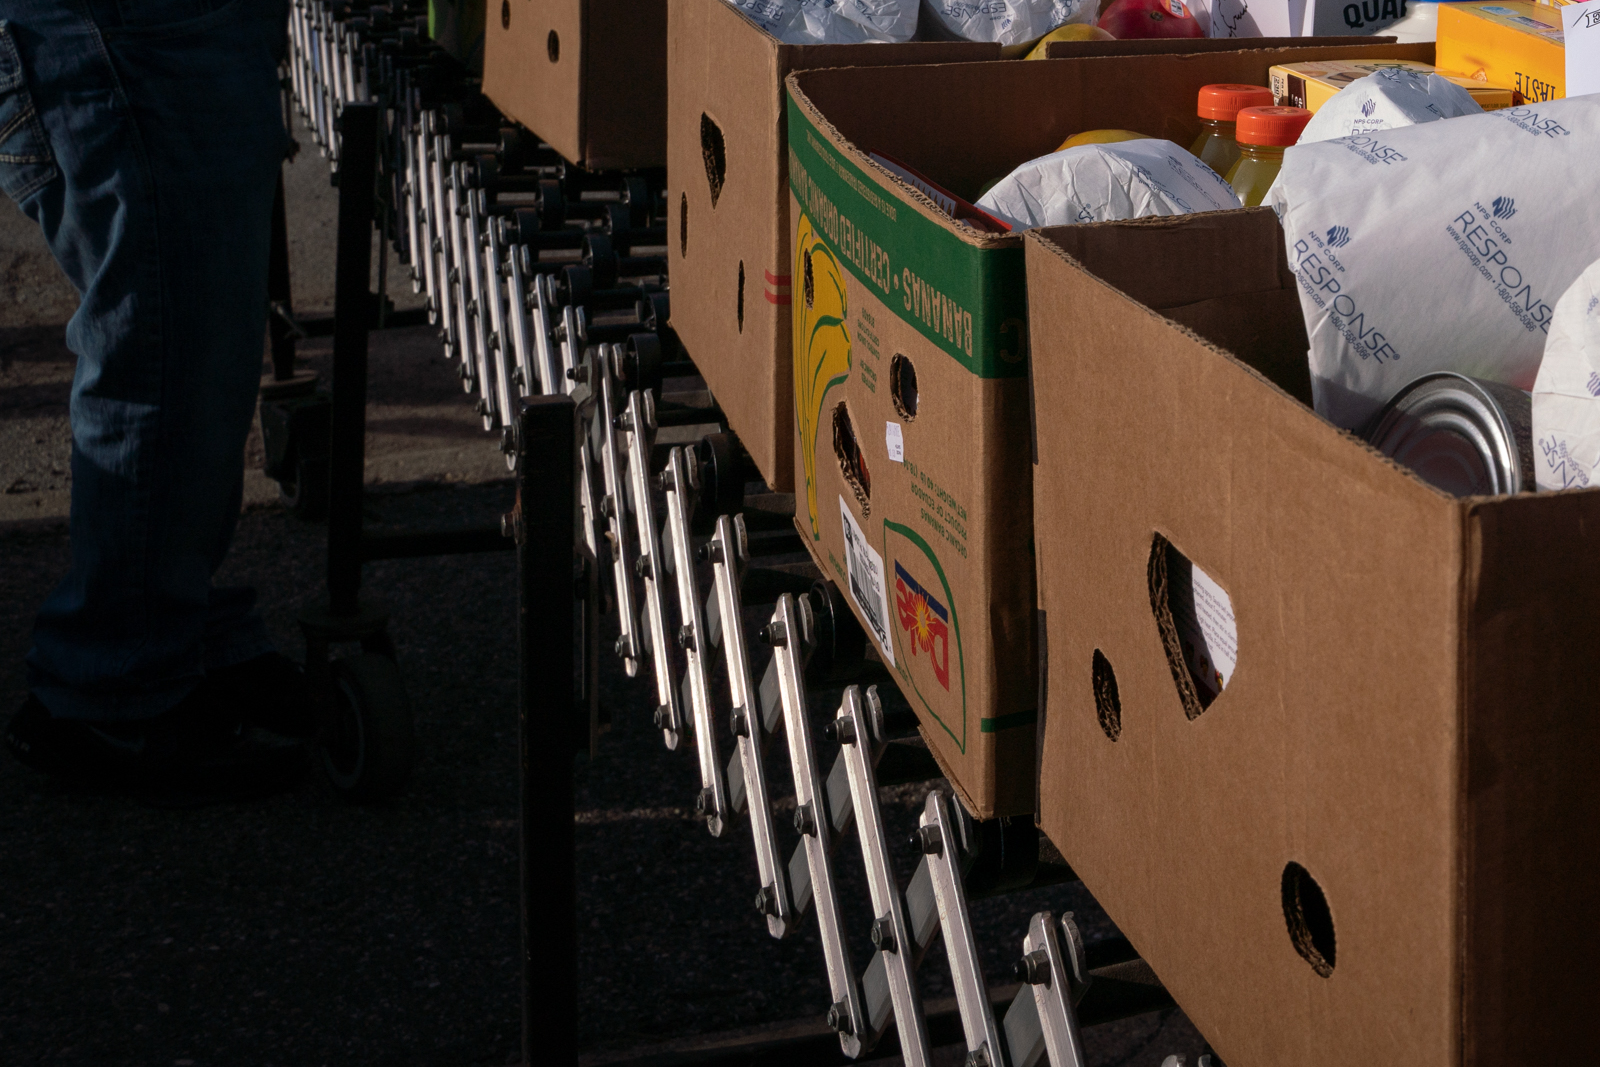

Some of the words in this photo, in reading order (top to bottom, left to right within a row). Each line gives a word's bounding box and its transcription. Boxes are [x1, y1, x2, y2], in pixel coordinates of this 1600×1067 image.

[1514, 72, 1556, 104] TASTE
[1473, 201, 1490, 219] NPS
[1489, 218, 1512, 245] CORP
[839, 213, 891, 296] CERTIFIED
[1308, 230, 1325, 247] NPS
[1323, 245, 1346, 274] CORP
[1446, 224, 1494, 281] www.npscorp.com
[1494, 283, 1537, 333] 1-800-558-5066
[903, 267, 973, 358] BANANAS
[1327, 310, 1372, 361] 1-800-558-5066
[910, 480, 935, 509] ECUADOR
[936, 505, 944, 518] OF
[945, 512, 967, 541] PRODUCT
[896, 577, 949, 693] Dole
